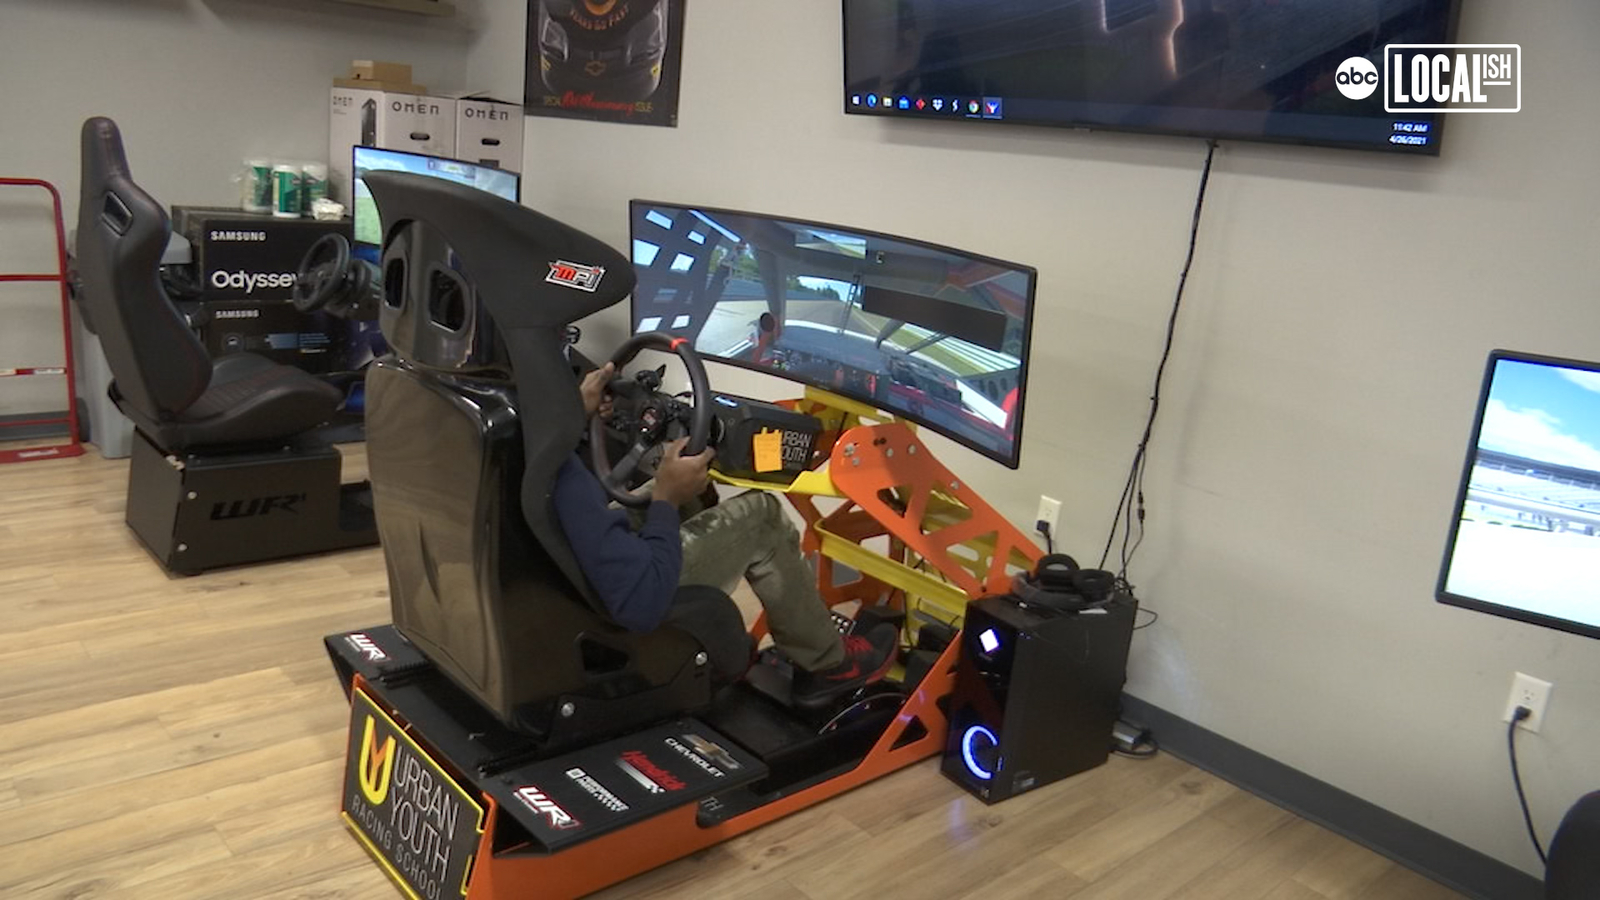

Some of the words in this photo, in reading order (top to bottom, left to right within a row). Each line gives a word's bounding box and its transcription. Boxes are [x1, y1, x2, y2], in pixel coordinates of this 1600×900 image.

[392, 101, 439, 115] OMEN
[465, 108, 508, 121] OMEN
[211, 231, 266, 241] SAMSUNG
[215, 309, 260, 319] SAMSUNG
[782, 430, 812, 449] RBAN
[781, 445, 808, 463] OUTH
[664, 737, 725, 778] CHEVROLET
[394, 745, 460, 840] URBAN
[352, 794, 392, 850] RACING
[390, 786, 450, 882] YOUTH
